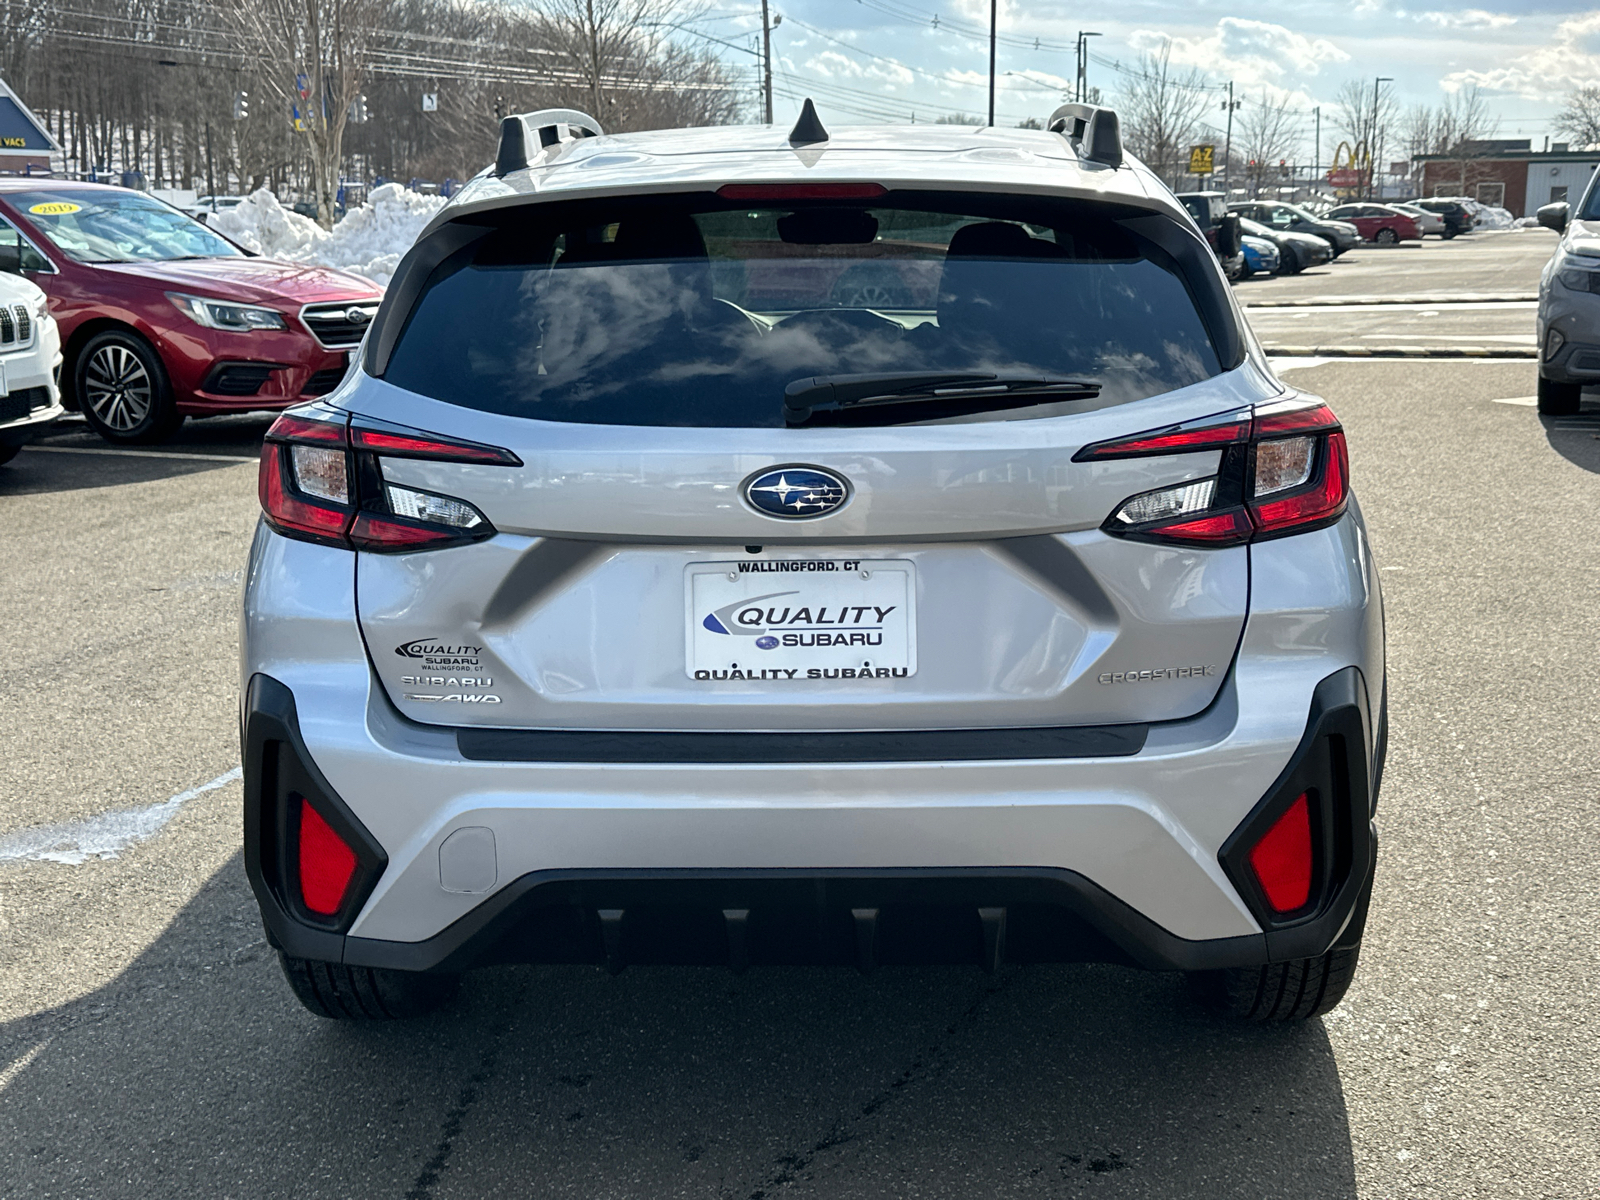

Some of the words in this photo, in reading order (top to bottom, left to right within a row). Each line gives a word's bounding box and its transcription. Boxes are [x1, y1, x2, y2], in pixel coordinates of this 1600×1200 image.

[3, 137, 26, 147] VACS
[39, 204, 73, 214] 2019
[738, 561, 840, 573] WALLINGFORD,
[844, 561, 861, 571] CT
[737, 606, 897, 626] QUALITY
[782, 633, 883, 647] SUBARU
[410, 645, 483, 655] QUALITY
[425, 657, 479, 665] SUBARU
[694, 668, 798, 681] QUALITY
[806, 667, 908, 679] SUBARU
[1097, 664, 1216, 685] CROSSTREK
[400, 676, 493, 688] SUBARU
[440, 694, 503, 703] AWD
